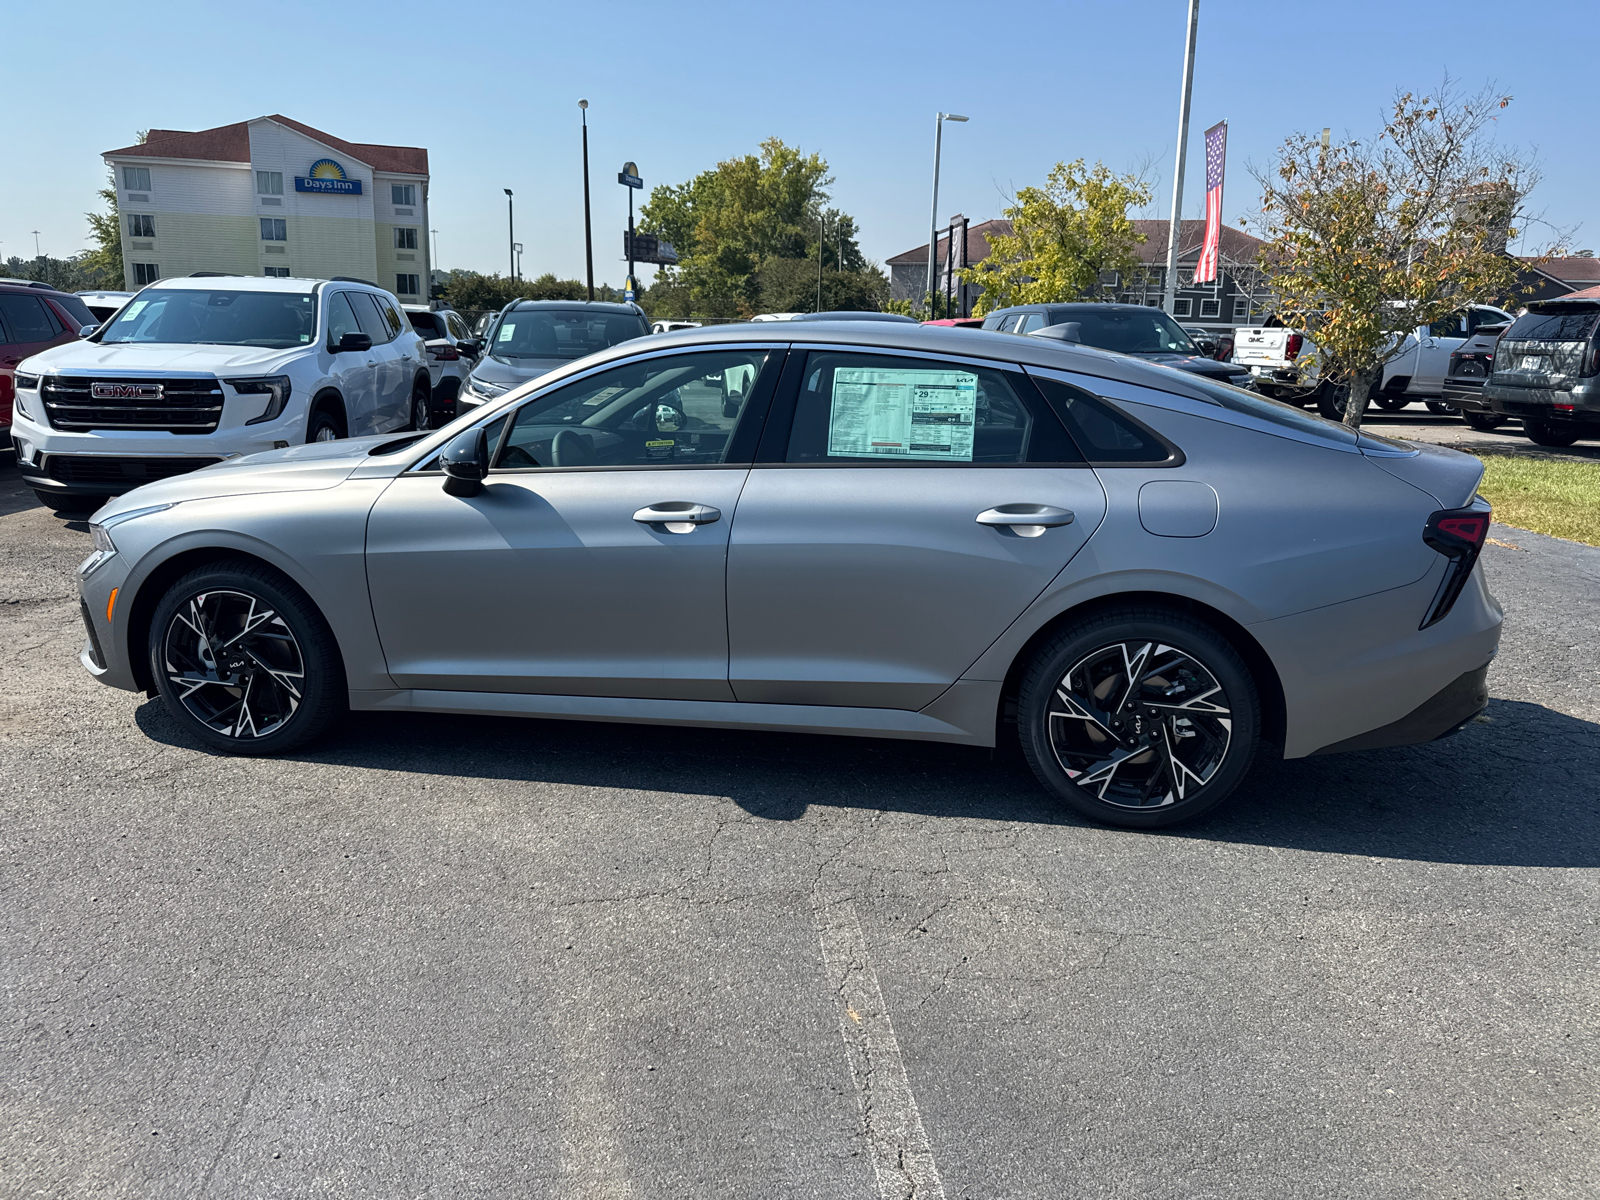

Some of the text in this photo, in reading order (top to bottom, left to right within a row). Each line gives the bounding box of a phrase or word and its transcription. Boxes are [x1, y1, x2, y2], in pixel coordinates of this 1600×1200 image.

[304, 179, 353, 190] Days Inn
[95, 384, 156, 398] GMC
[918, 390, 929, 398] 29
[229, 660, 245, 669] KIA
